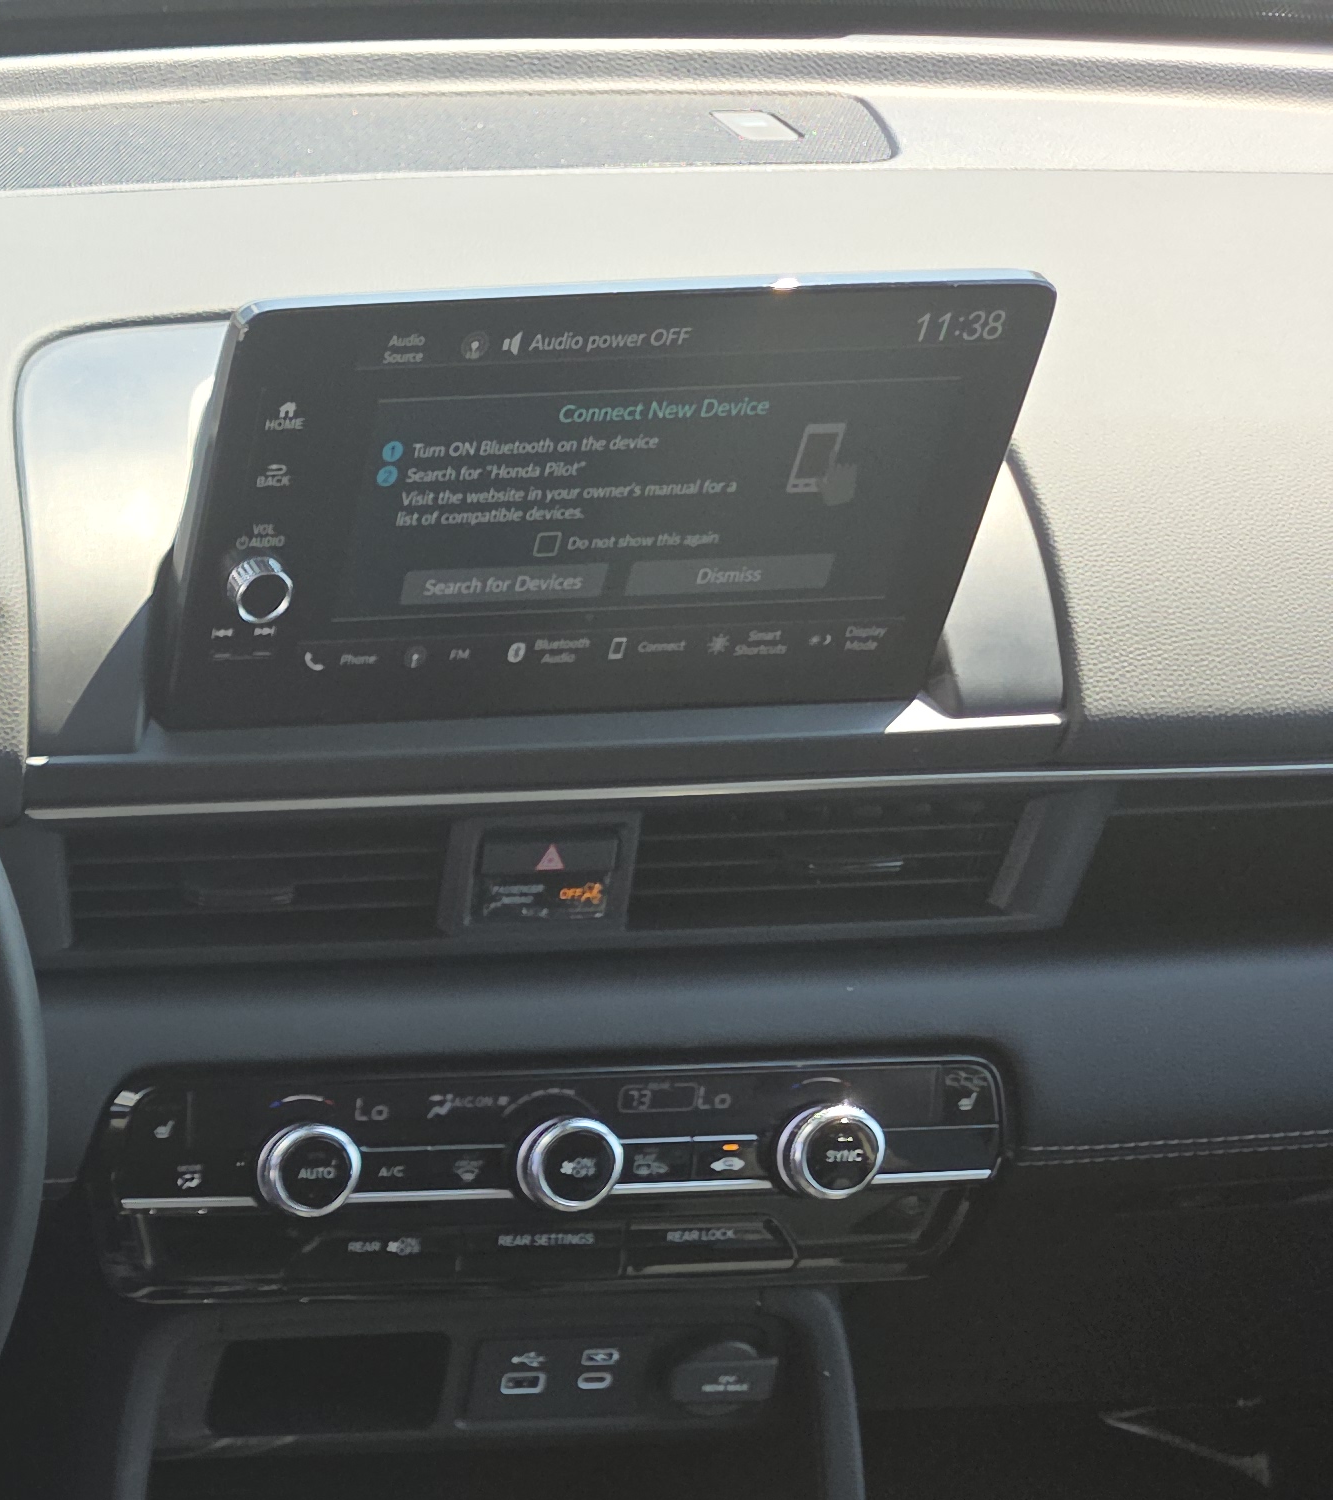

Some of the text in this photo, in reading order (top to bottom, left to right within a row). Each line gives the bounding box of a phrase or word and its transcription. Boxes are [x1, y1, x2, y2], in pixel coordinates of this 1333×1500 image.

[917, 309, 1006, 342] 11:38
[388, 333, 425, 348] Audio
[529, 327, 692, 354] Audio power OFF
[383, 350, 423, 363] Source
[558, 397, 770, 423] Connect New Device
[264, 417, 304, 431] HOME
[413, 443, 445, 459] Turn
[448, 441, 477, 457] ON
[479, 438, 555, 456] Bluetooth
[557, 439, 577, 453] on
[581, 436, 606, 452] the
[609, 433, 658, 451] device
[405, 467, 455, 483] Search
[459, 464, 483, 481] for
[486, 463, 540, 480] "Honda
[543, 460, 587, 478] Pilot"
[256, 475, 292, 488] BACK
[401, 490, 435, 507] Visit
[438, 489, 463, 505] the
[466, 487, 524, 504] website
[527, 486, 542, 501] in
[544, 486, 580, 504] your
[583, 481, 642, 499] owner's
[645, 480, 699, 497] manual
[702, 479, 725, 495] for
[395, 505, 585, 527] list of compatible devices.
[253, 523, 275, 535] VOL
[568, 531, 720, 551] Do not show this again
[696, 566, 762, 585] Dismiss
[423, 573, 584, 597] Search for Devices
[825, 1149, 864, 1162] SYNC
[298, 1166, 335, 1180] AUTO
[378, 1165, 406, 1178] A/C
[498, 1232, 596, 1247] REAR SETTINGS
[667, 1227, 735, 1242] REAR LOCK
[348, 1240, 382, 1253] REAR
